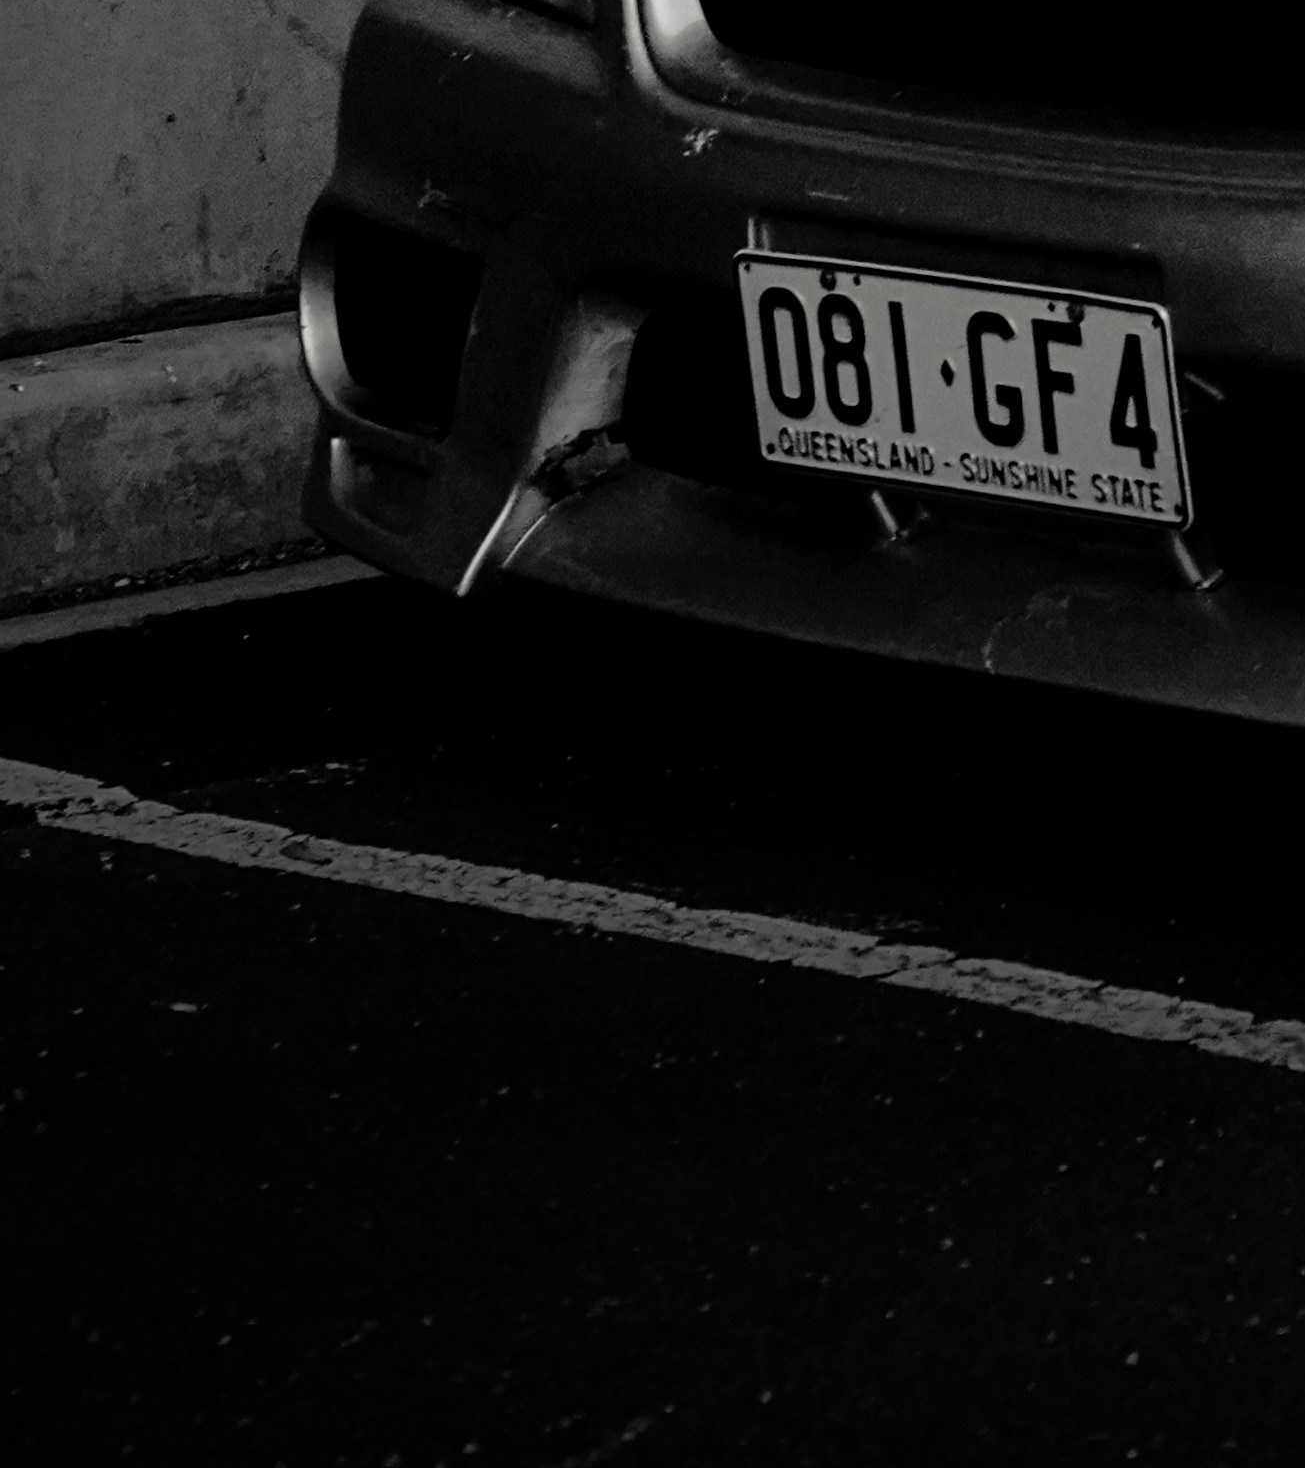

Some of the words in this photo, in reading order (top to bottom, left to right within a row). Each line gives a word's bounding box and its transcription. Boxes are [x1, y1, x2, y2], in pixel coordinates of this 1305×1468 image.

[779, 427, 935, 476] QUEENSLAND
[960, 452, 1078, 500] SUNSHINE
[1091, 473, 1165, 513] STATE
